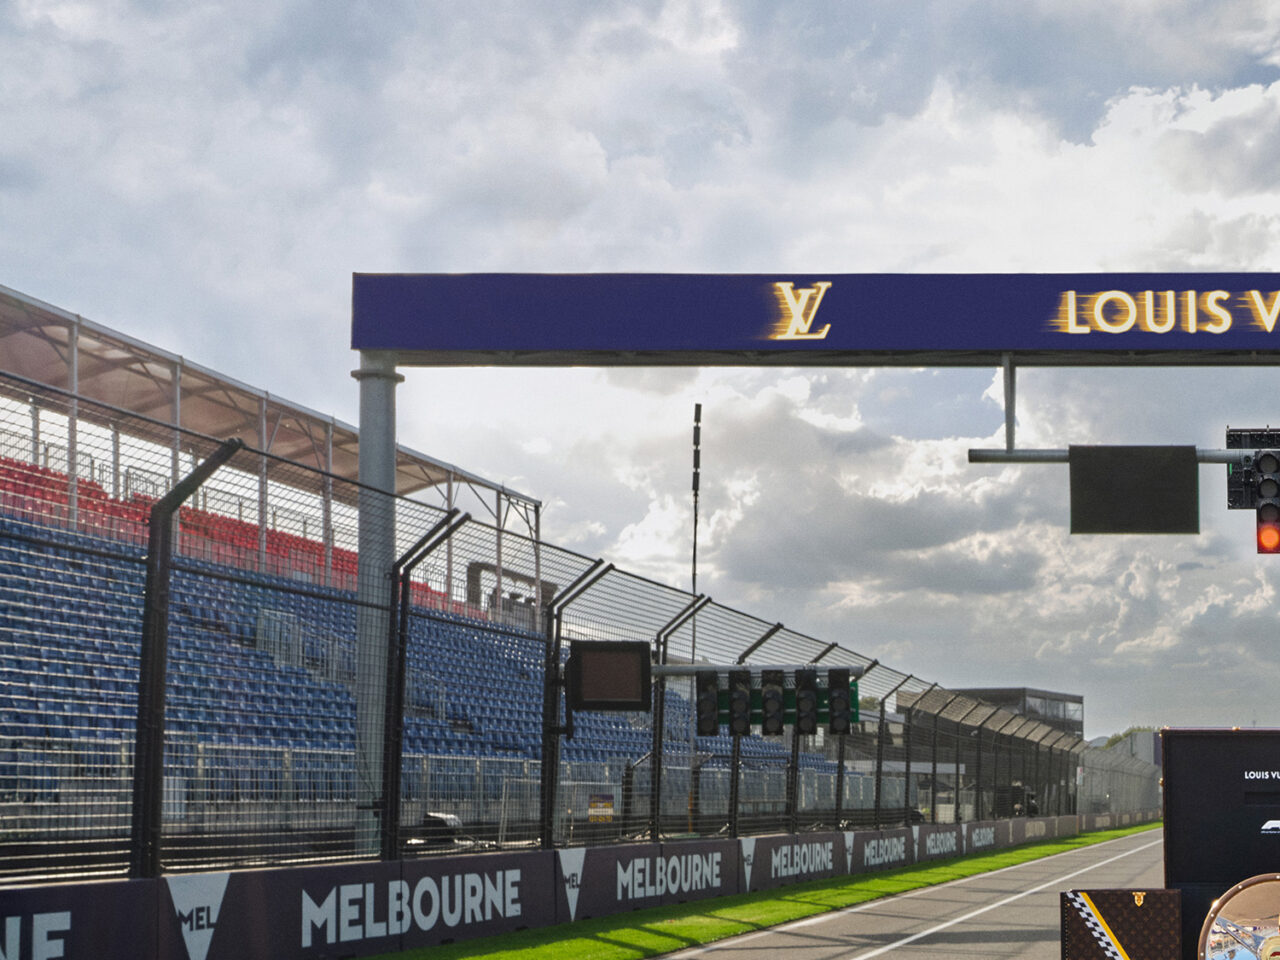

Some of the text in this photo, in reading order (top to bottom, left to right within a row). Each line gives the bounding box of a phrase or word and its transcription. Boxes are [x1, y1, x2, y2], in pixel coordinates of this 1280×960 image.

[1062, 290, 1232, 334] LOUIS
[1244, 771, 1269, 779] LOUIS
[864, 836, 906, 866] MELBOURNE
[926, 831, 957, 855] MELBOURNE
[771, 841, 833, 879] MELBOURNE
[564, 873, 581, 889] MEL
[617, 852, 721, 901] MELBOURNE
[177, 905, 217, 932] MEL
[302, 869, 521, 948] MELBOURNE
